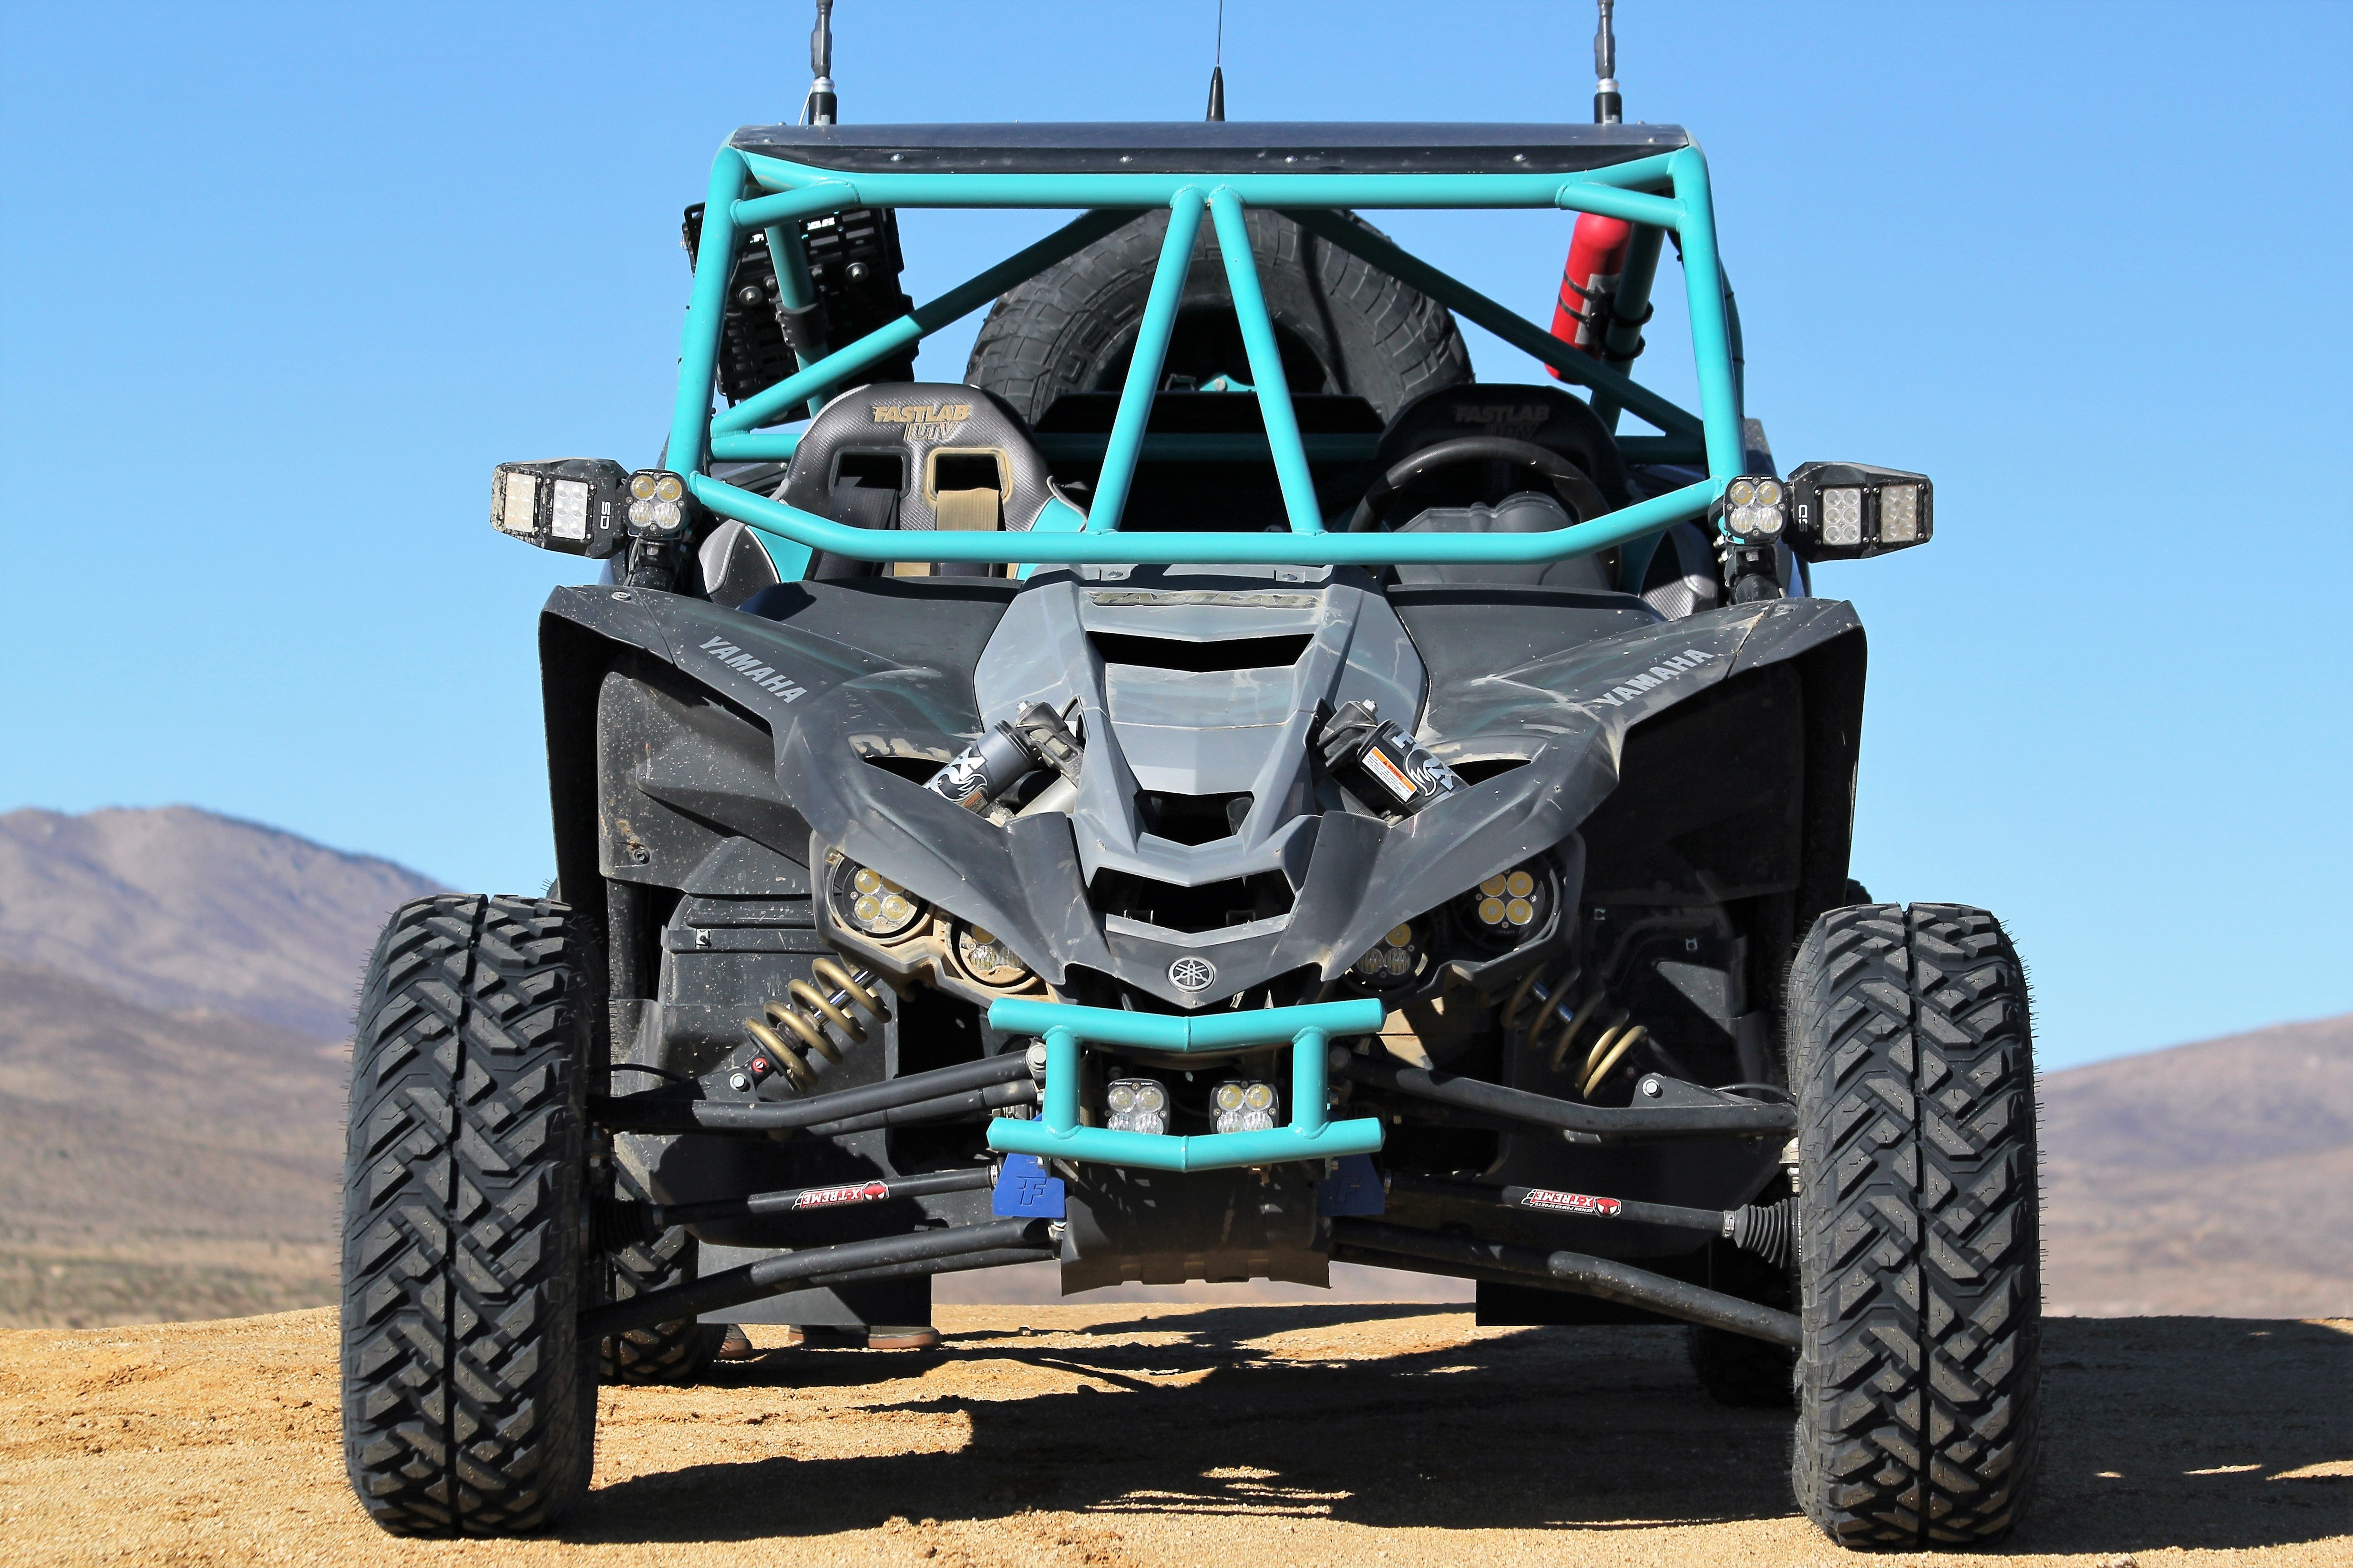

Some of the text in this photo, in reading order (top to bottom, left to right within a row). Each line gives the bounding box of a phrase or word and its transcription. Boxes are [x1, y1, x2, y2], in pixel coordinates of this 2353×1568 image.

[872, 404, 970, 423] FASTLAB
[1455, 404, 1550, 423] FASTLAB
[1086, 591, 1322, 607] FASTLAB
[699, 635, 807, 703] YAMAHA
[1593, 649, 1715, 706] YAMAHA
[1387, 764, 1404, 780] WARNING
[802, 1188, 861, 1205] X-TREME
[1534, 1191, 1593, 1207] X-TREME
[1534, 1202, 1574, 1210] POWERSPORTS
